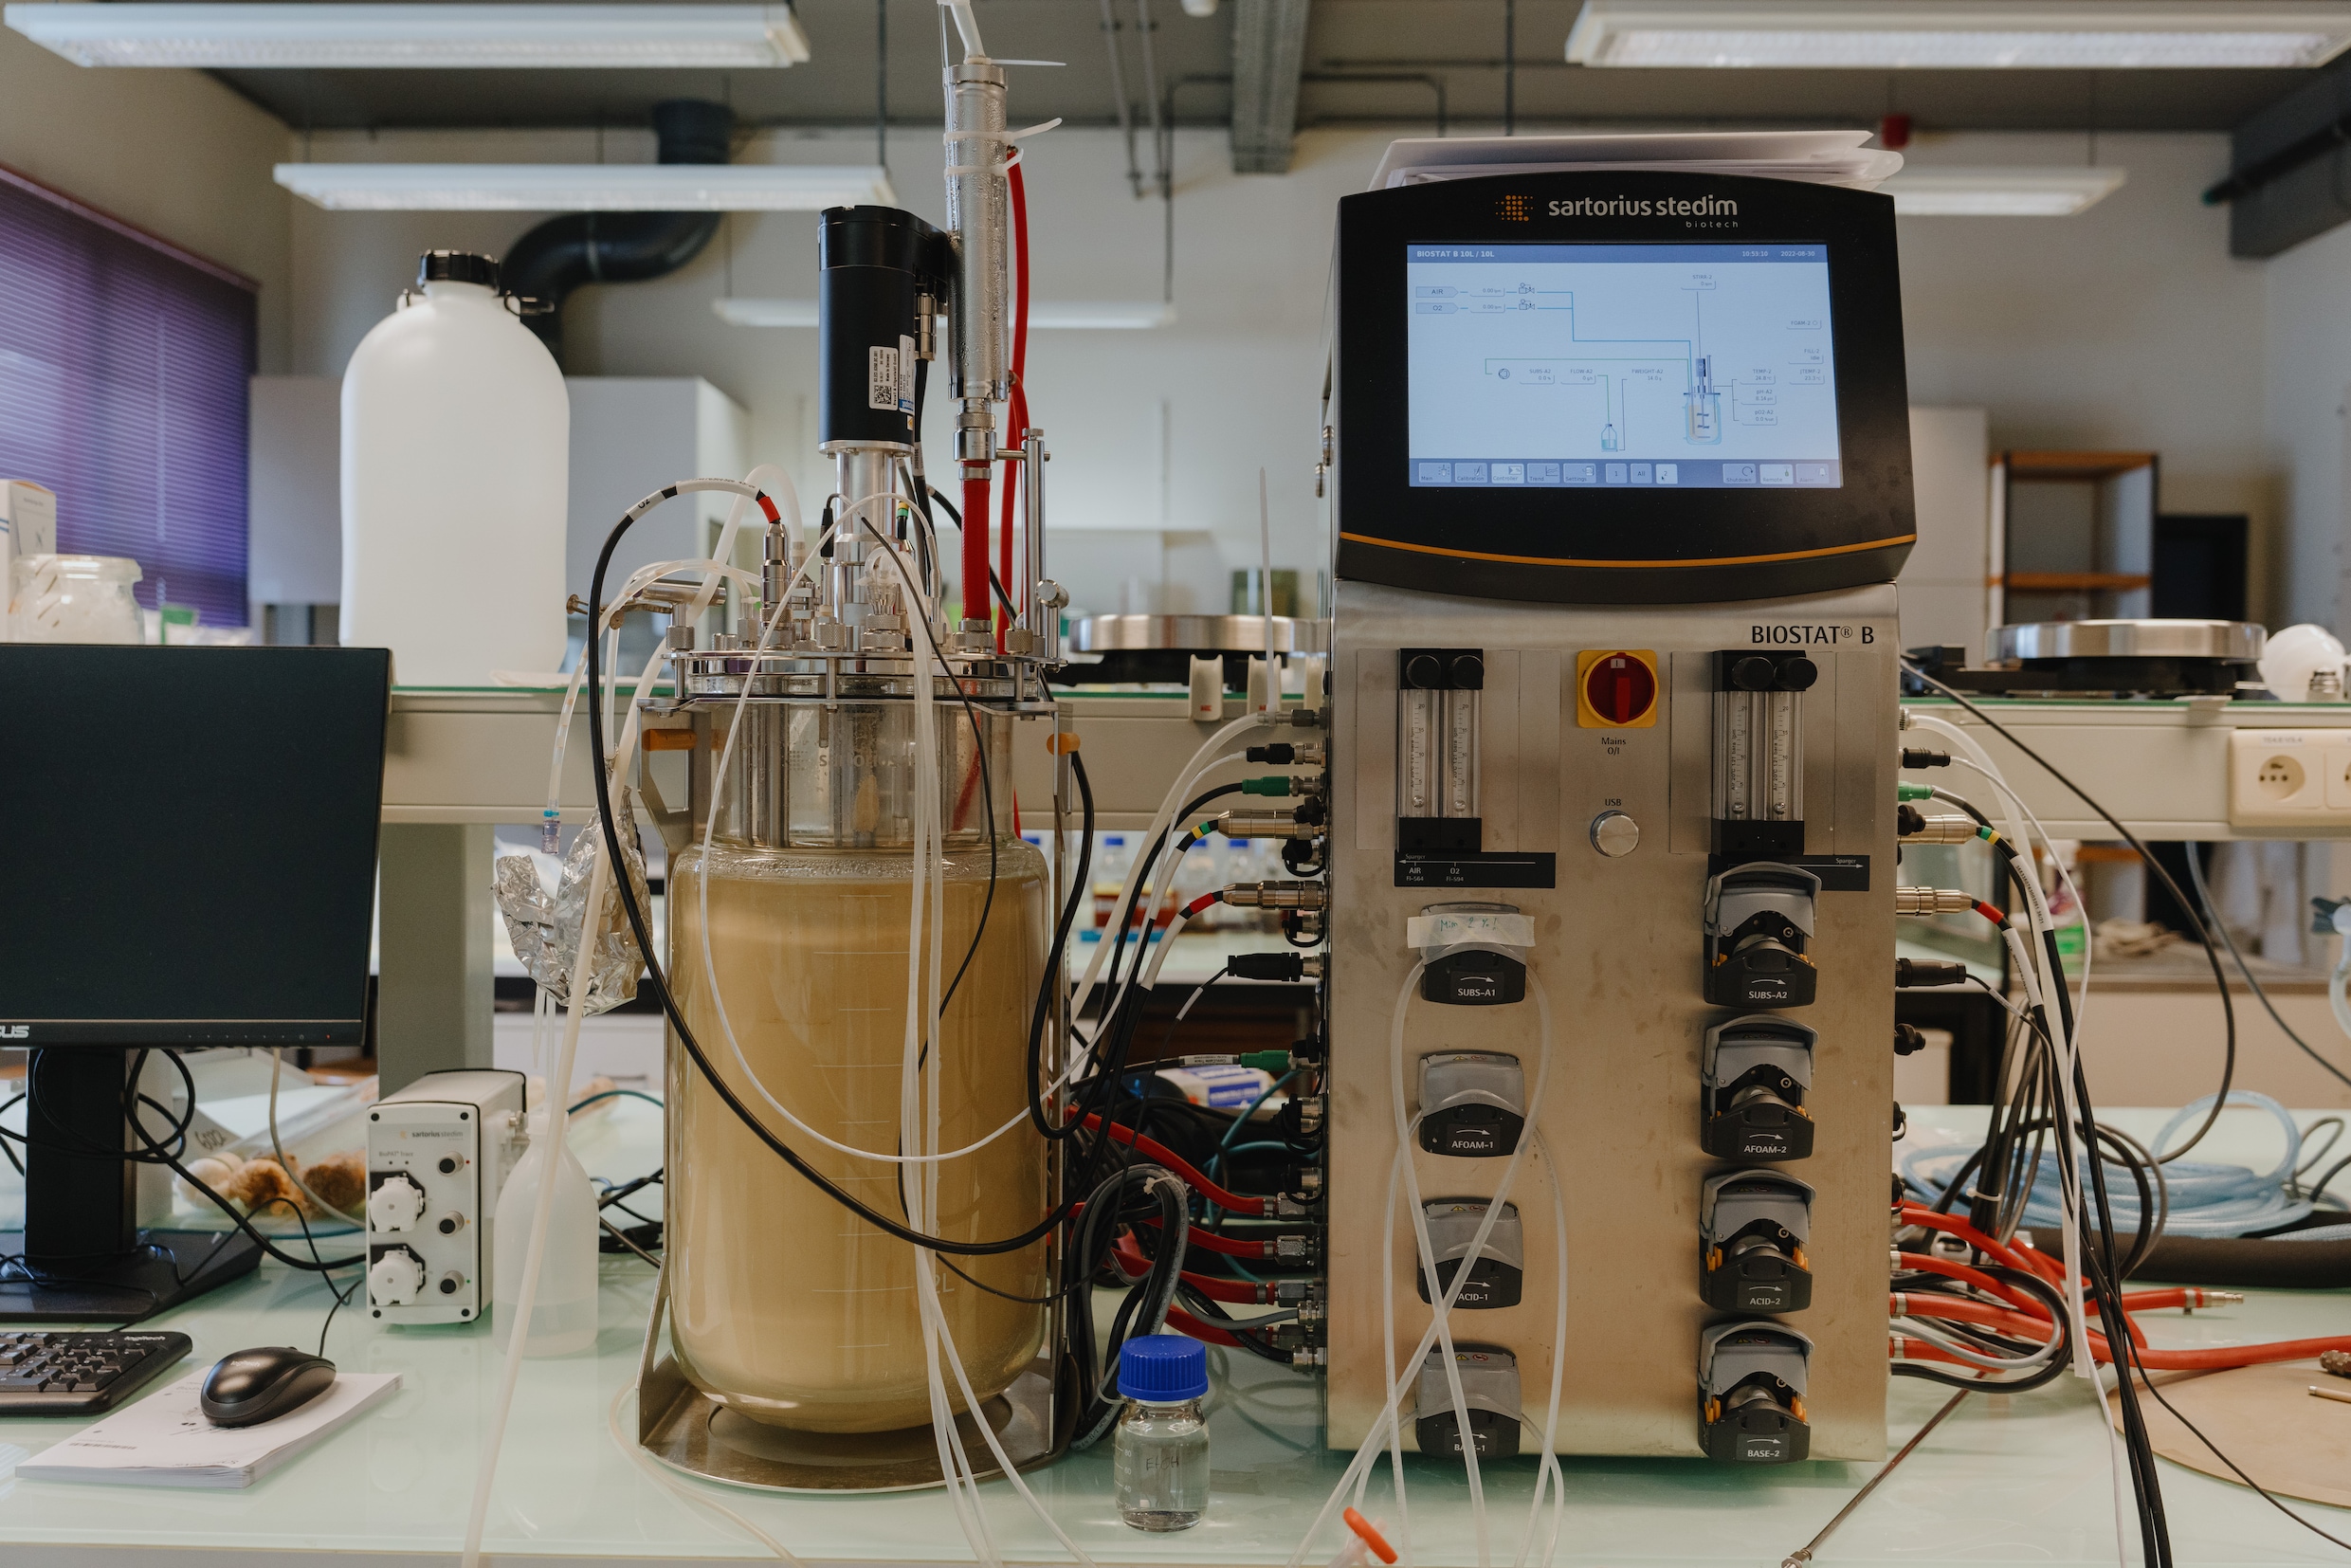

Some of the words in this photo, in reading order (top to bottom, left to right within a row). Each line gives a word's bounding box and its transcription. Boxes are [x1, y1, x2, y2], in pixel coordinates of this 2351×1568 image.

[1548, 194, 1652, 216] sartorius
[1655, 194, 1738, 216] stedim
[1686, 220, 1739, 228] biotech
[1862, 626, 1874, 644] B
[1457, 988, 1496, 996] SUBS-A1
[1749, 991, 1788, 999] SUBS-A2
[0, 1025, 30, 1039] US
[1452, 1140, 1494, 1149] AFOAM-1
[1744, 1145, 1787, 1153] AFOAM-2
